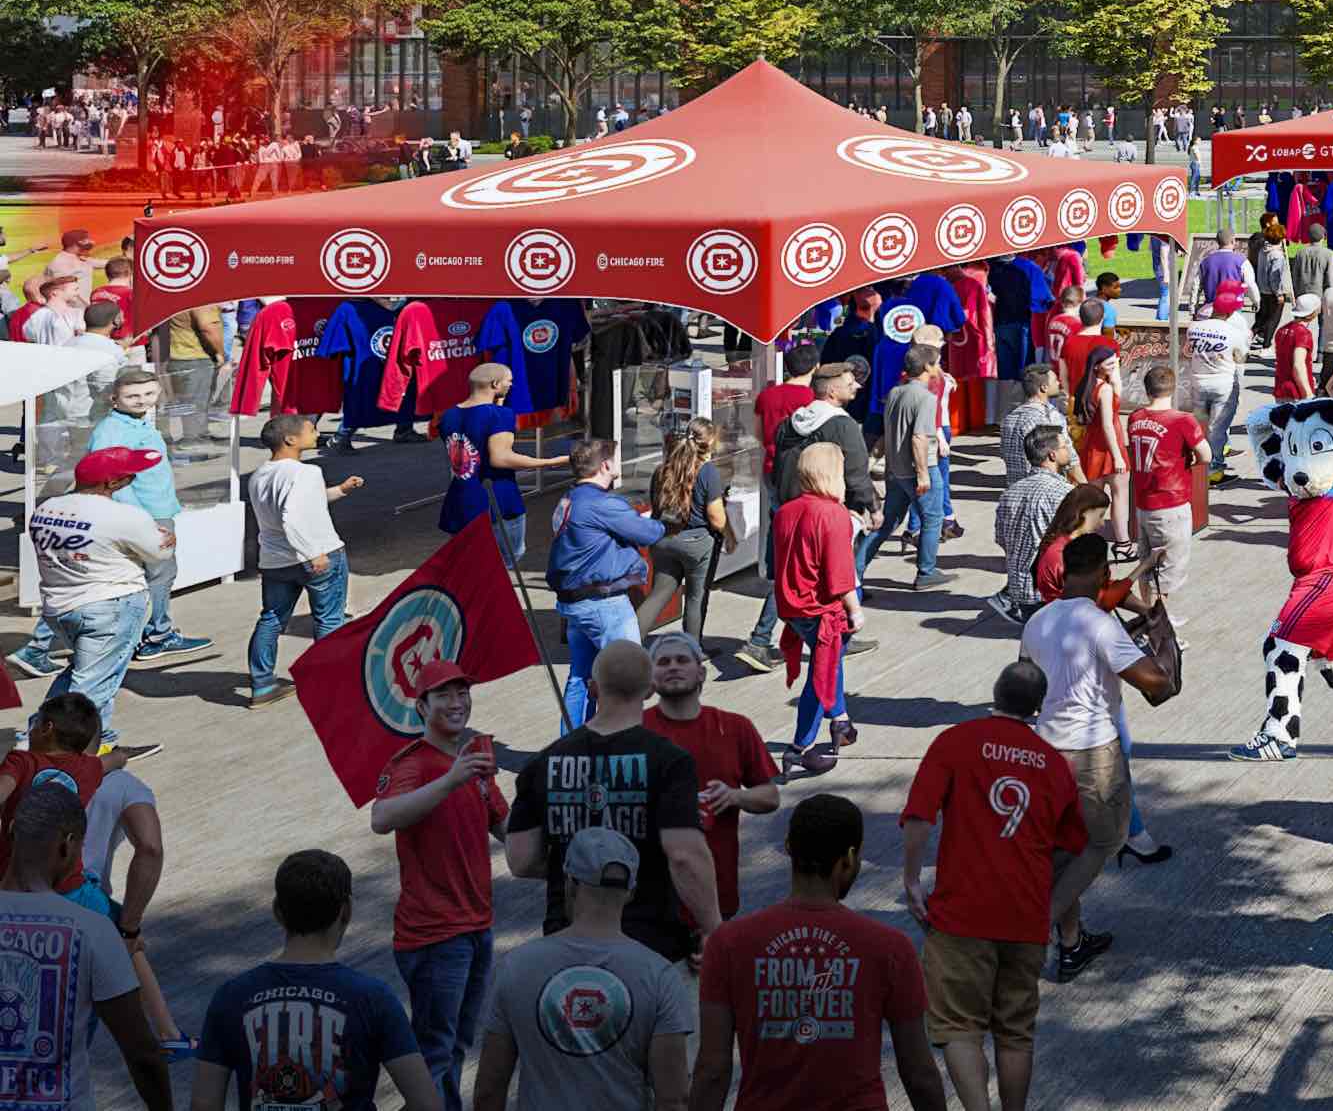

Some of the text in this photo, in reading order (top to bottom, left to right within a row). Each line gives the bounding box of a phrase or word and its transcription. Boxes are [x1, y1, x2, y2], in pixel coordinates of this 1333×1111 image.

[428, 256, 483, 266] CHICAGO FIRE
[609, 257, 665, 266] CHICAGO FIRE
[1130, 435, 1160, 473] 17
[982, 742, 1047, 769] CUYPERS
[547, 755, 591, 789] FOR
[989, 776, 1031, 838] 9
[754, 957, 816, 986] FROM
[253, 985, 336, 1004] CHICAGO
[757, 989, 856, 1018] FOREVER
[242, 1000, 348, 1082] FIRE
